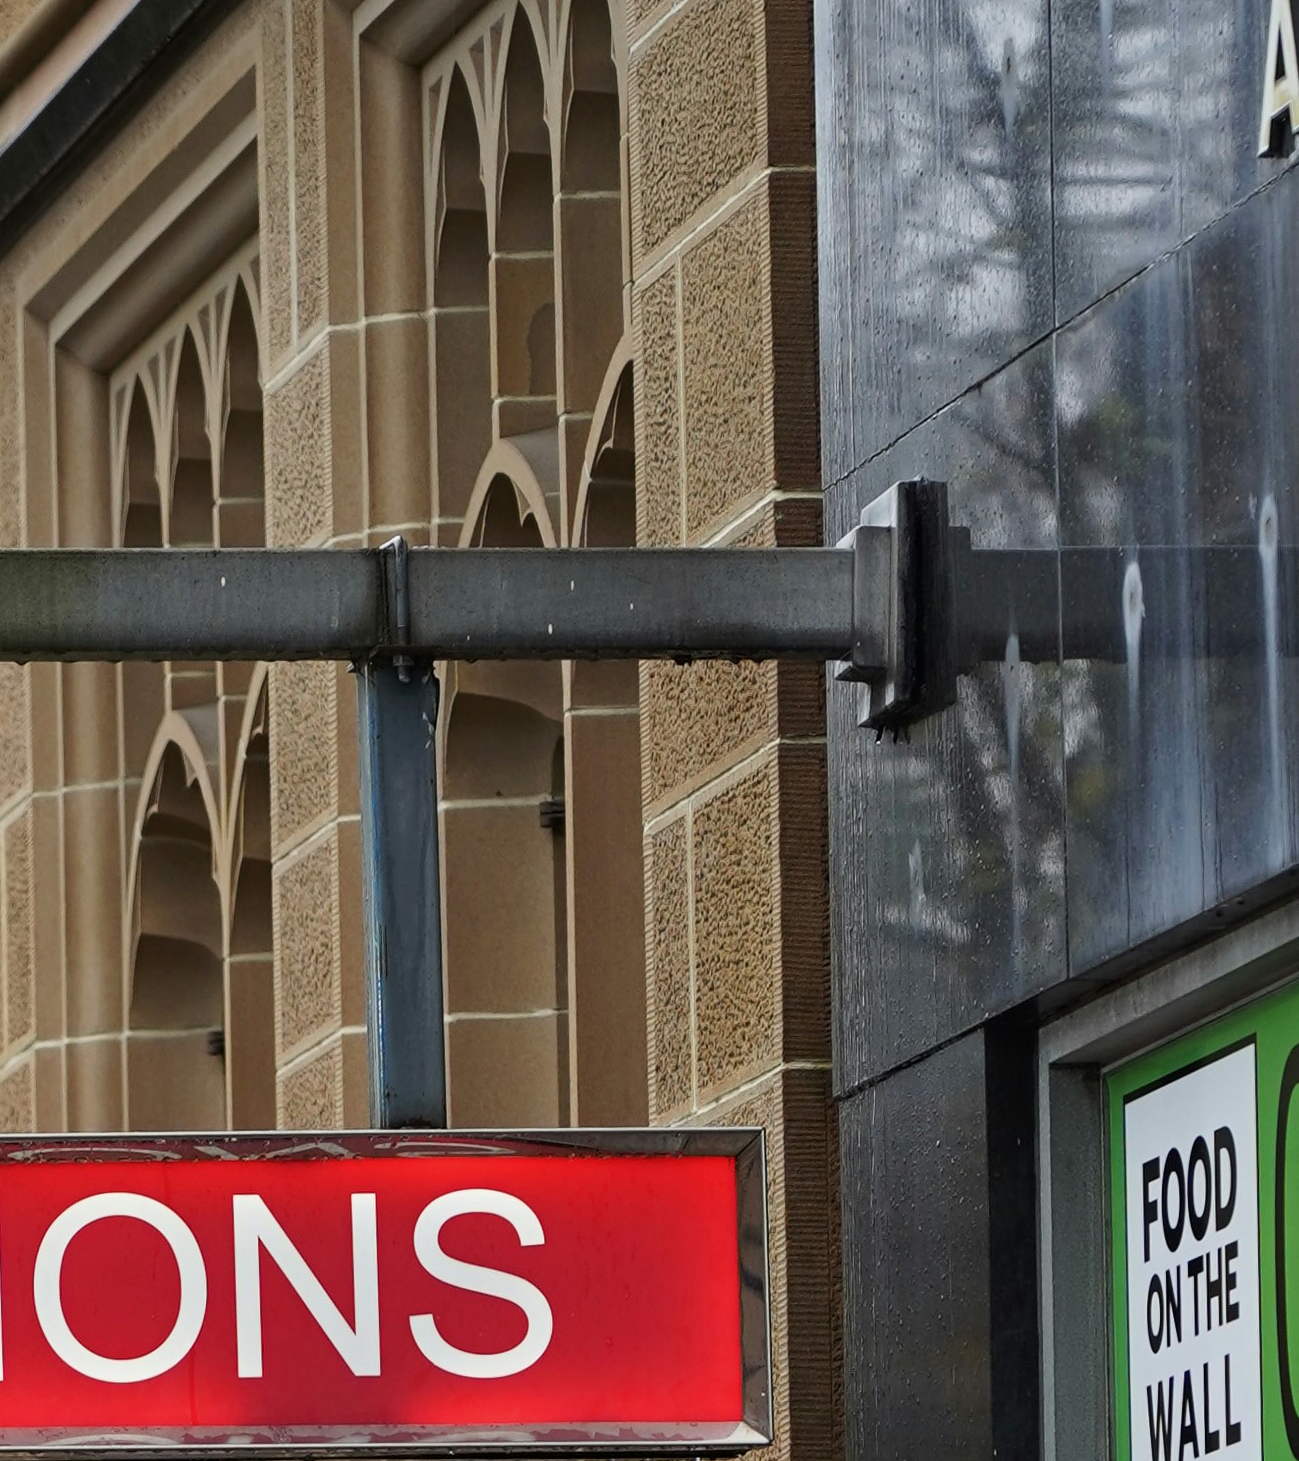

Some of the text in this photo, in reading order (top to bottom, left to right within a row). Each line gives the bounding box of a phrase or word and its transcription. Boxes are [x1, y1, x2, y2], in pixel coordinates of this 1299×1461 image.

[1143, 1126, 1237, 1262] FOOD
[1146, 1240, 1240, 1355] ON THE
